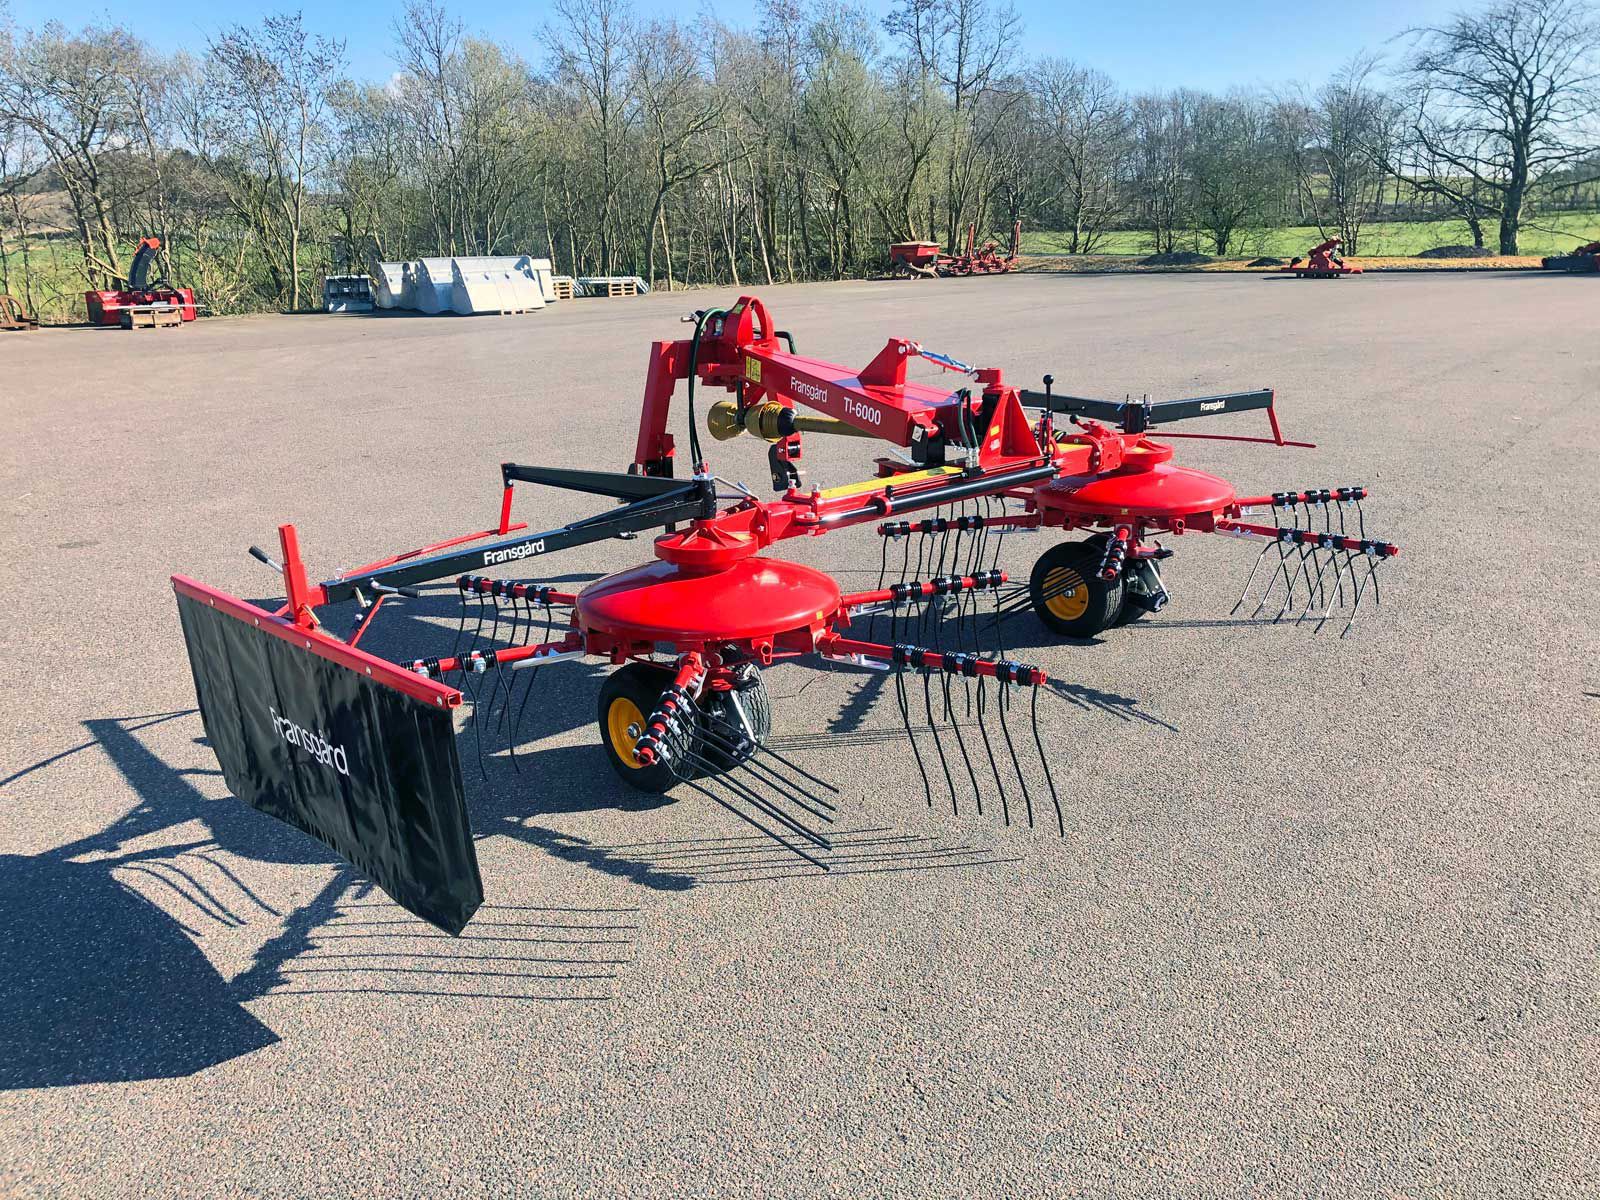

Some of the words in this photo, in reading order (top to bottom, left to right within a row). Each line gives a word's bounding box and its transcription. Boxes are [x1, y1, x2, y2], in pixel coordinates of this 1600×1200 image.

[790, 376, 828, 403] Fransgård
[843, 396, 882, 426] TI-6000
[483, 538, 545, 565] Fransgård
[269, 706, 350, 776] Fransgård
